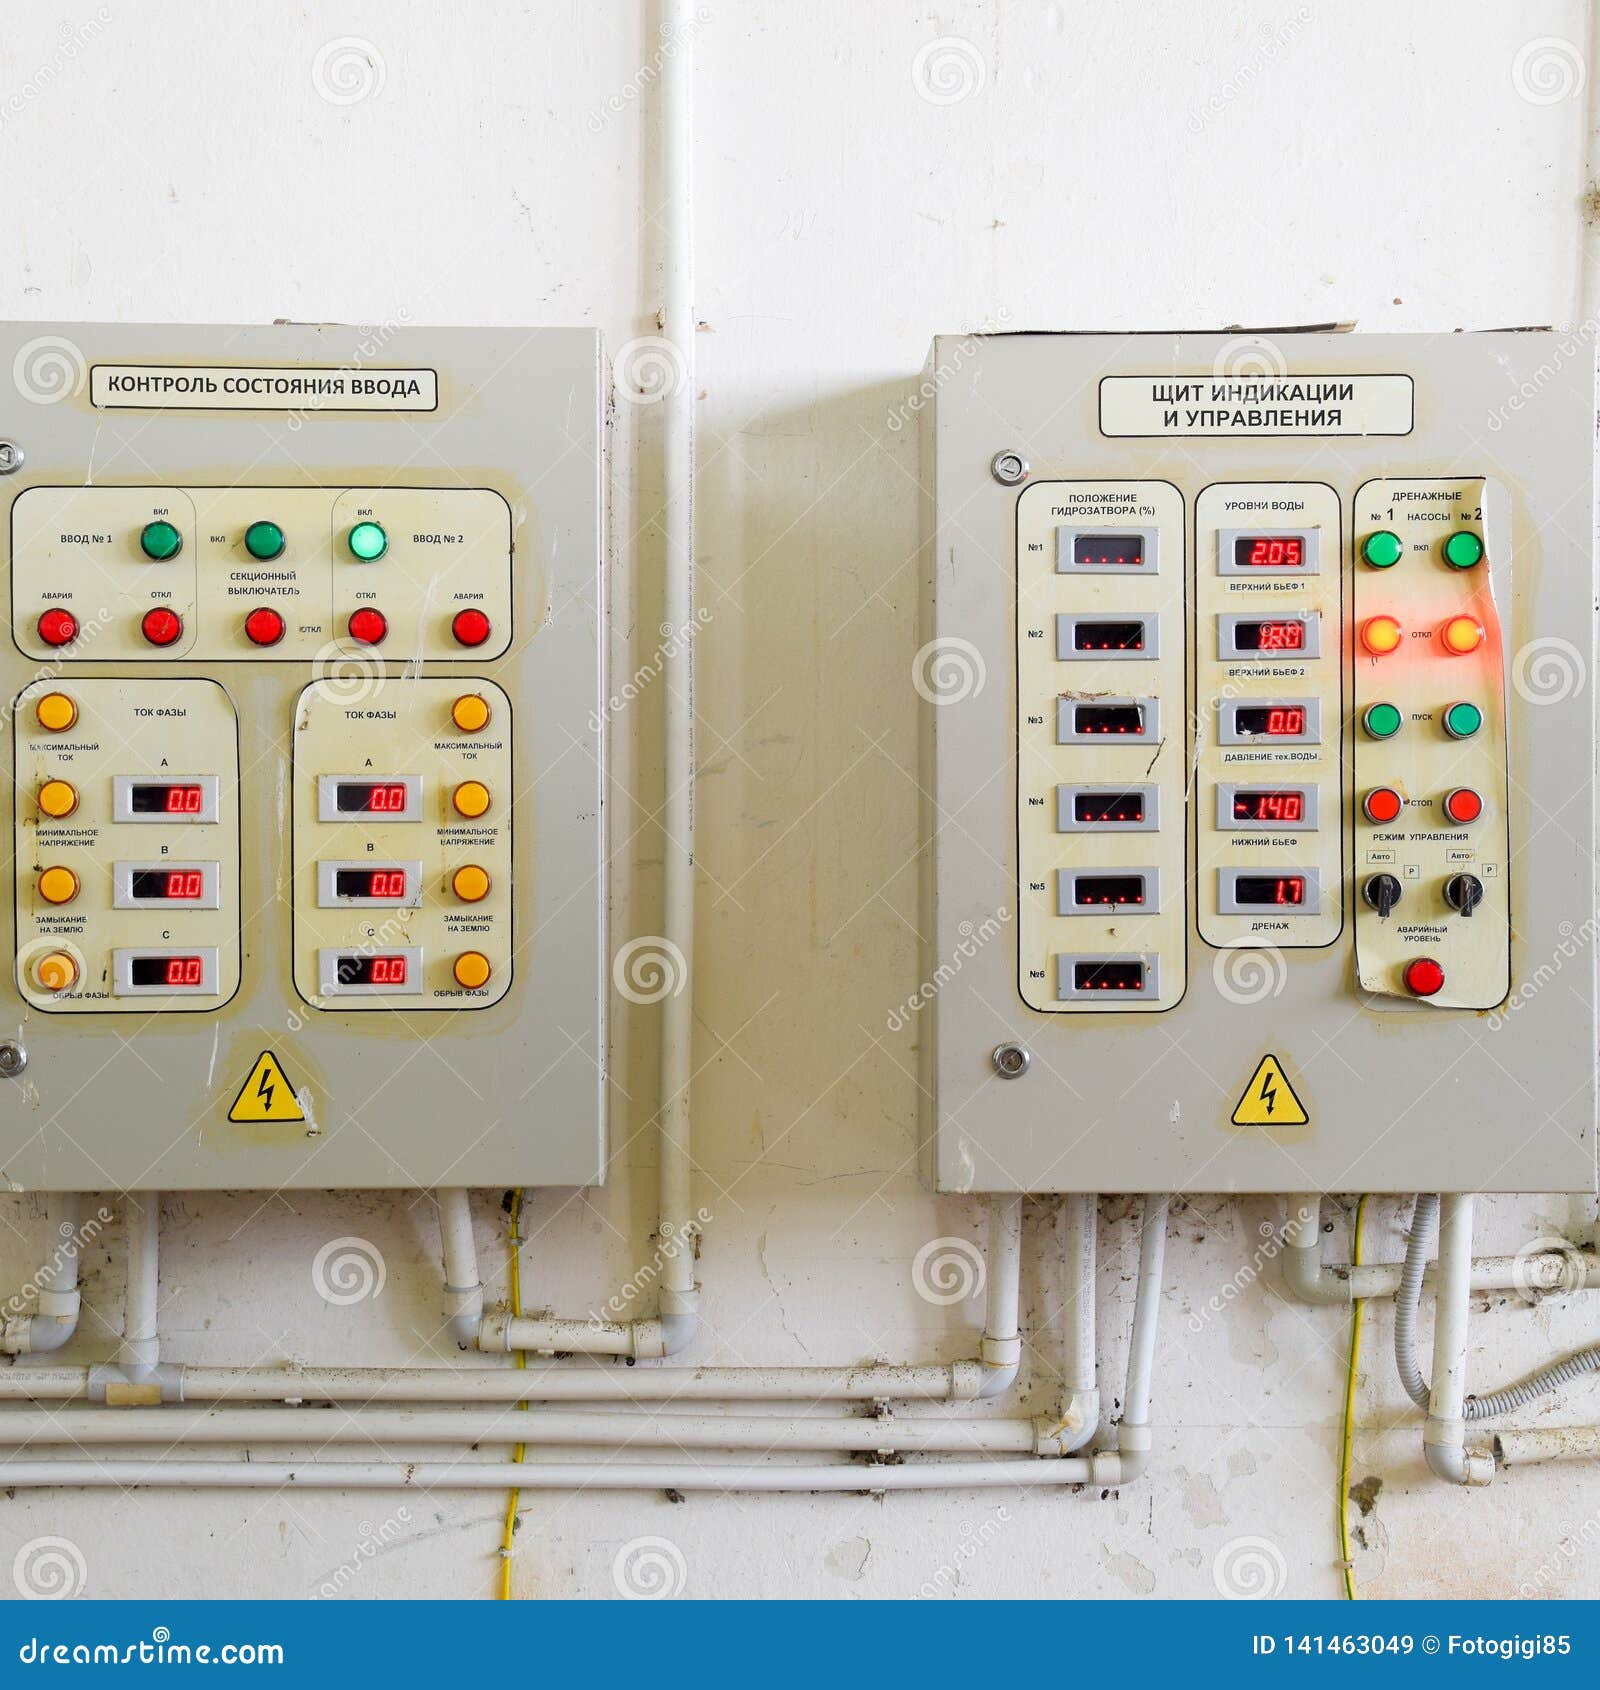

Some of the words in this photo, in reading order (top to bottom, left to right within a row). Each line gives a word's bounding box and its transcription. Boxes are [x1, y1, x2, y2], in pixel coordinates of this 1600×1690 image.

[109, 376, 217, 392] КОНТРОЛЬ
[224, 378, 344, 394] СОСТОЯНИЯ
[352, 380, 420, 398] ВВОДА
[1153, 385, 1204, 401] ЩИТ
[1212, 384, 1353, 404] ИНДИКАЦИИ
[1165, 411, 1177, 427] И
[1186, 410, 1341, 426] УПРАВЛЕНИЯ
[1069, 493, 1137, 503] ПОЛОЖЕНИЕ
[1391, 491, 1463, 502] ДРЕНАЖНЫЕ
[1051, 506, 1137, 516] ГИДРОЗАТВОРА
[1138, 505, 1156, 517] (%)
[1224, 501, 1269, 511] УРОВНИ
[1271, 501, 1305, 512] ВОДЫ
[153, 508, 169, 516] ВКЛ
[357, 508, 373, 516] ВКЛ
[1387, 508, 1393, 520] 1
[1407, 512, 1451, 521] НАСОСЫ
[1474, 508, 1482, 520] 2
[60, 534, 90, 545] ВВОД
[412, 534, 442, 545] ВВОД
[1027, 543, 1043, 552] №1
[1413, 544, 1430, 552] ВКЛ
[1251, 542, 1299, 564] 2.05
[229, 570, 297, 581] СЕКЦИОННЫЙ
[227, 587, 300, 596] ВЫКЛЮЧАТЕЛЬ
[1229, 583, 1272, 591] ВЕРХНИЙ
[41, 592, 73, 600] АВАРИЯ
[150, 591, 172, 599] ОТКЛ
[355, 591, 377, 599] ОТКЛ
[1027, 630, 1044, 639] №2
[1411, 631, 1433, 639] ОТКЛ
[1228, 668, 1271, 677] ВЕРХНИЙ
[133, 708, 154, 717] ТОК
[155, 708, 187, 717] ФАЗЫ
[344, 710, 364, 720] ТОК
[366, 710, 397, 719] ФАЗЫ
[1027, 716, 1044, 725] №3
[1411, 713, 1433, 722] ПУСК
[1269, 712, 1300, 733] 0.0
[434, 742, 503, 750] МАКСИМАЛЬНЫЙ
[57, 753, 74, 761] ТОК
[461, 752, 478, 760] ТОК
[1224, 753, 1273, 762] ДАВЛЕНИЕ
[169, 790, 199, 811] 0.0
[372, 789, 403, 809] 0.0
[1028, 797, 1044, 806] №4
[1410, 799, 1433, 808] СТОП
[35, 829, 99, 837] МИНИМАЛЬНОЕ
[436, 828, 499, 836] МИНИМАЛЬНОЕ
[1372, 833, 1406, 841] РЕЖИМ
[1409, 833, 1469, 841] УПРАВЛЕНИЯ
[38, 839, 96, 847] НАПРЯЖЕНИЕ
[1231, 838, 1270, 846] НИЖНИЙ
[1450, 851, 1470, 861] Авто
[169, 875, 199, 896] 0.0
[372, 874, 403, 895] 0.0
[1029, 882, 1046, 891] №5
[1277, 881, 1301, 903] 1.7
[35, 916, 87, 924] ЗАМЫКАНИЕ
[443, 915, 494, 923] ЗАМЫКАНИЕ
[39, 926, 52, 934] НА
[52, 926, 84, 934] ЗЕМЛЮ
[447, 925, 459, 933] НА
[460, 924, 490, 932] ЗЕМЛЮ
[1251, 922, 1290, 932] ДРЕНАЖ
[1403, 935, 1441, 943] УРОВЕНЬ
[169, 962, 199, 982] 0.0
[373, 961, 403, 981] 0.0
[1029, 970, 1046, 979] №6
[84, 991, 110, 999] ФАЗЫ
[433, 989, 464, 998] ОБРЫВ
[465, 989, 490, 997] ФАЗЫ
